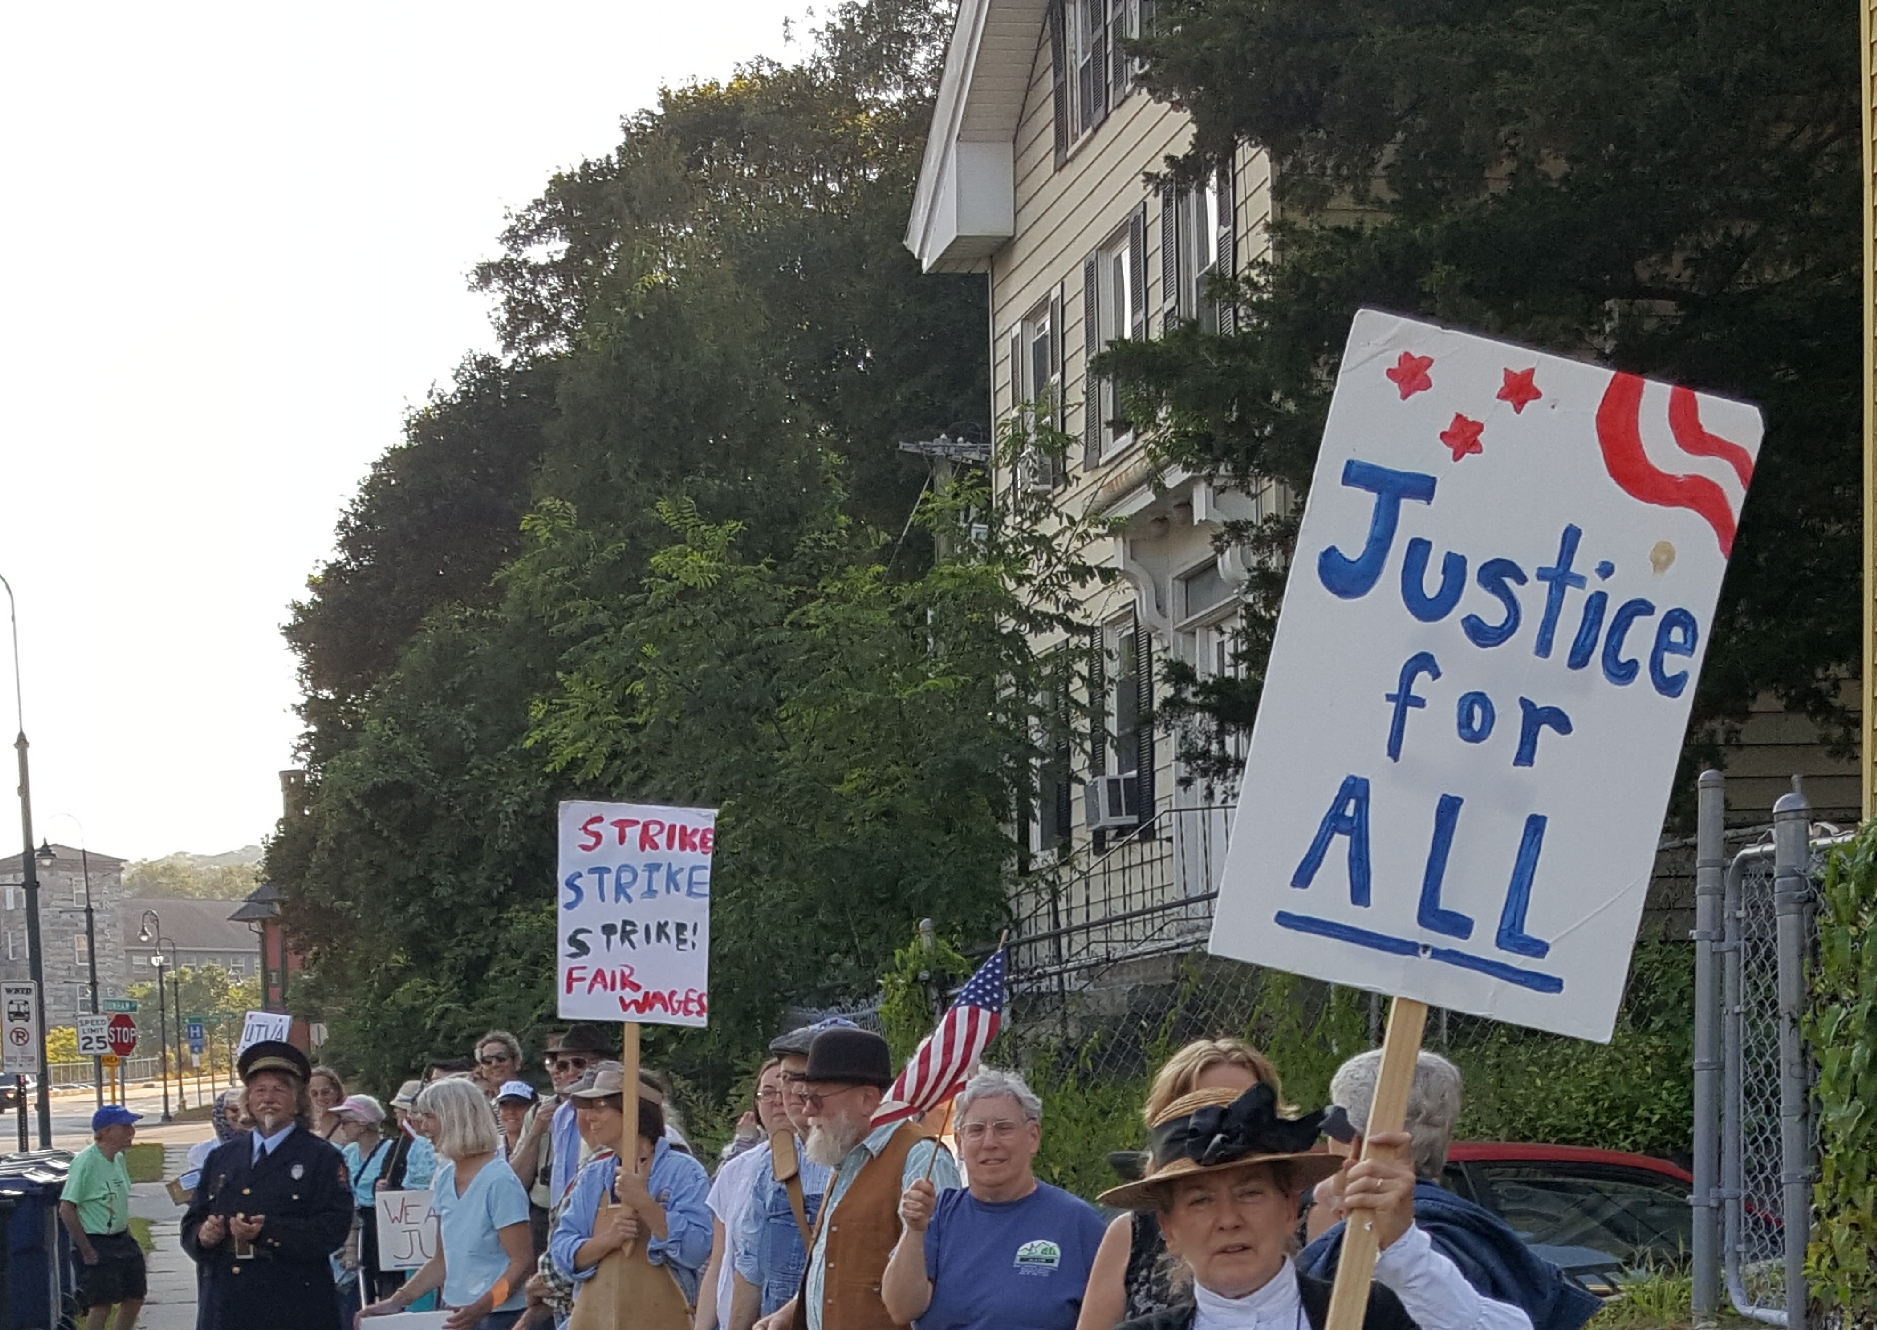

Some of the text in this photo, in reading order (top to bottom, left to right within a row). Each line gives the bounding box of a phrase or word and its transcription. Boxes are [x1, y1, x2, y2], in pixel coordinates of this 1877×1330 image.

[1317, 459, 1699, 698] Justice
[1384, 651, 1574, 768] for
[577, 815, 715, 855] STRIKE
[1290, 774, 1550, 960] ALL
[562, 861, 710, 911] STRIKE
[564, 919, 699, 959] STRIKE!
[565, 964, 643, 995] FAIR
[618, 988, 708, 1018] WAGES
[81, 1035, 108, 1051] 25
[82, 1027, 104, 1035] LIMIT
[108, 1027, 136, 1043] STOP
[383, 1197, 421, 1225] WE
